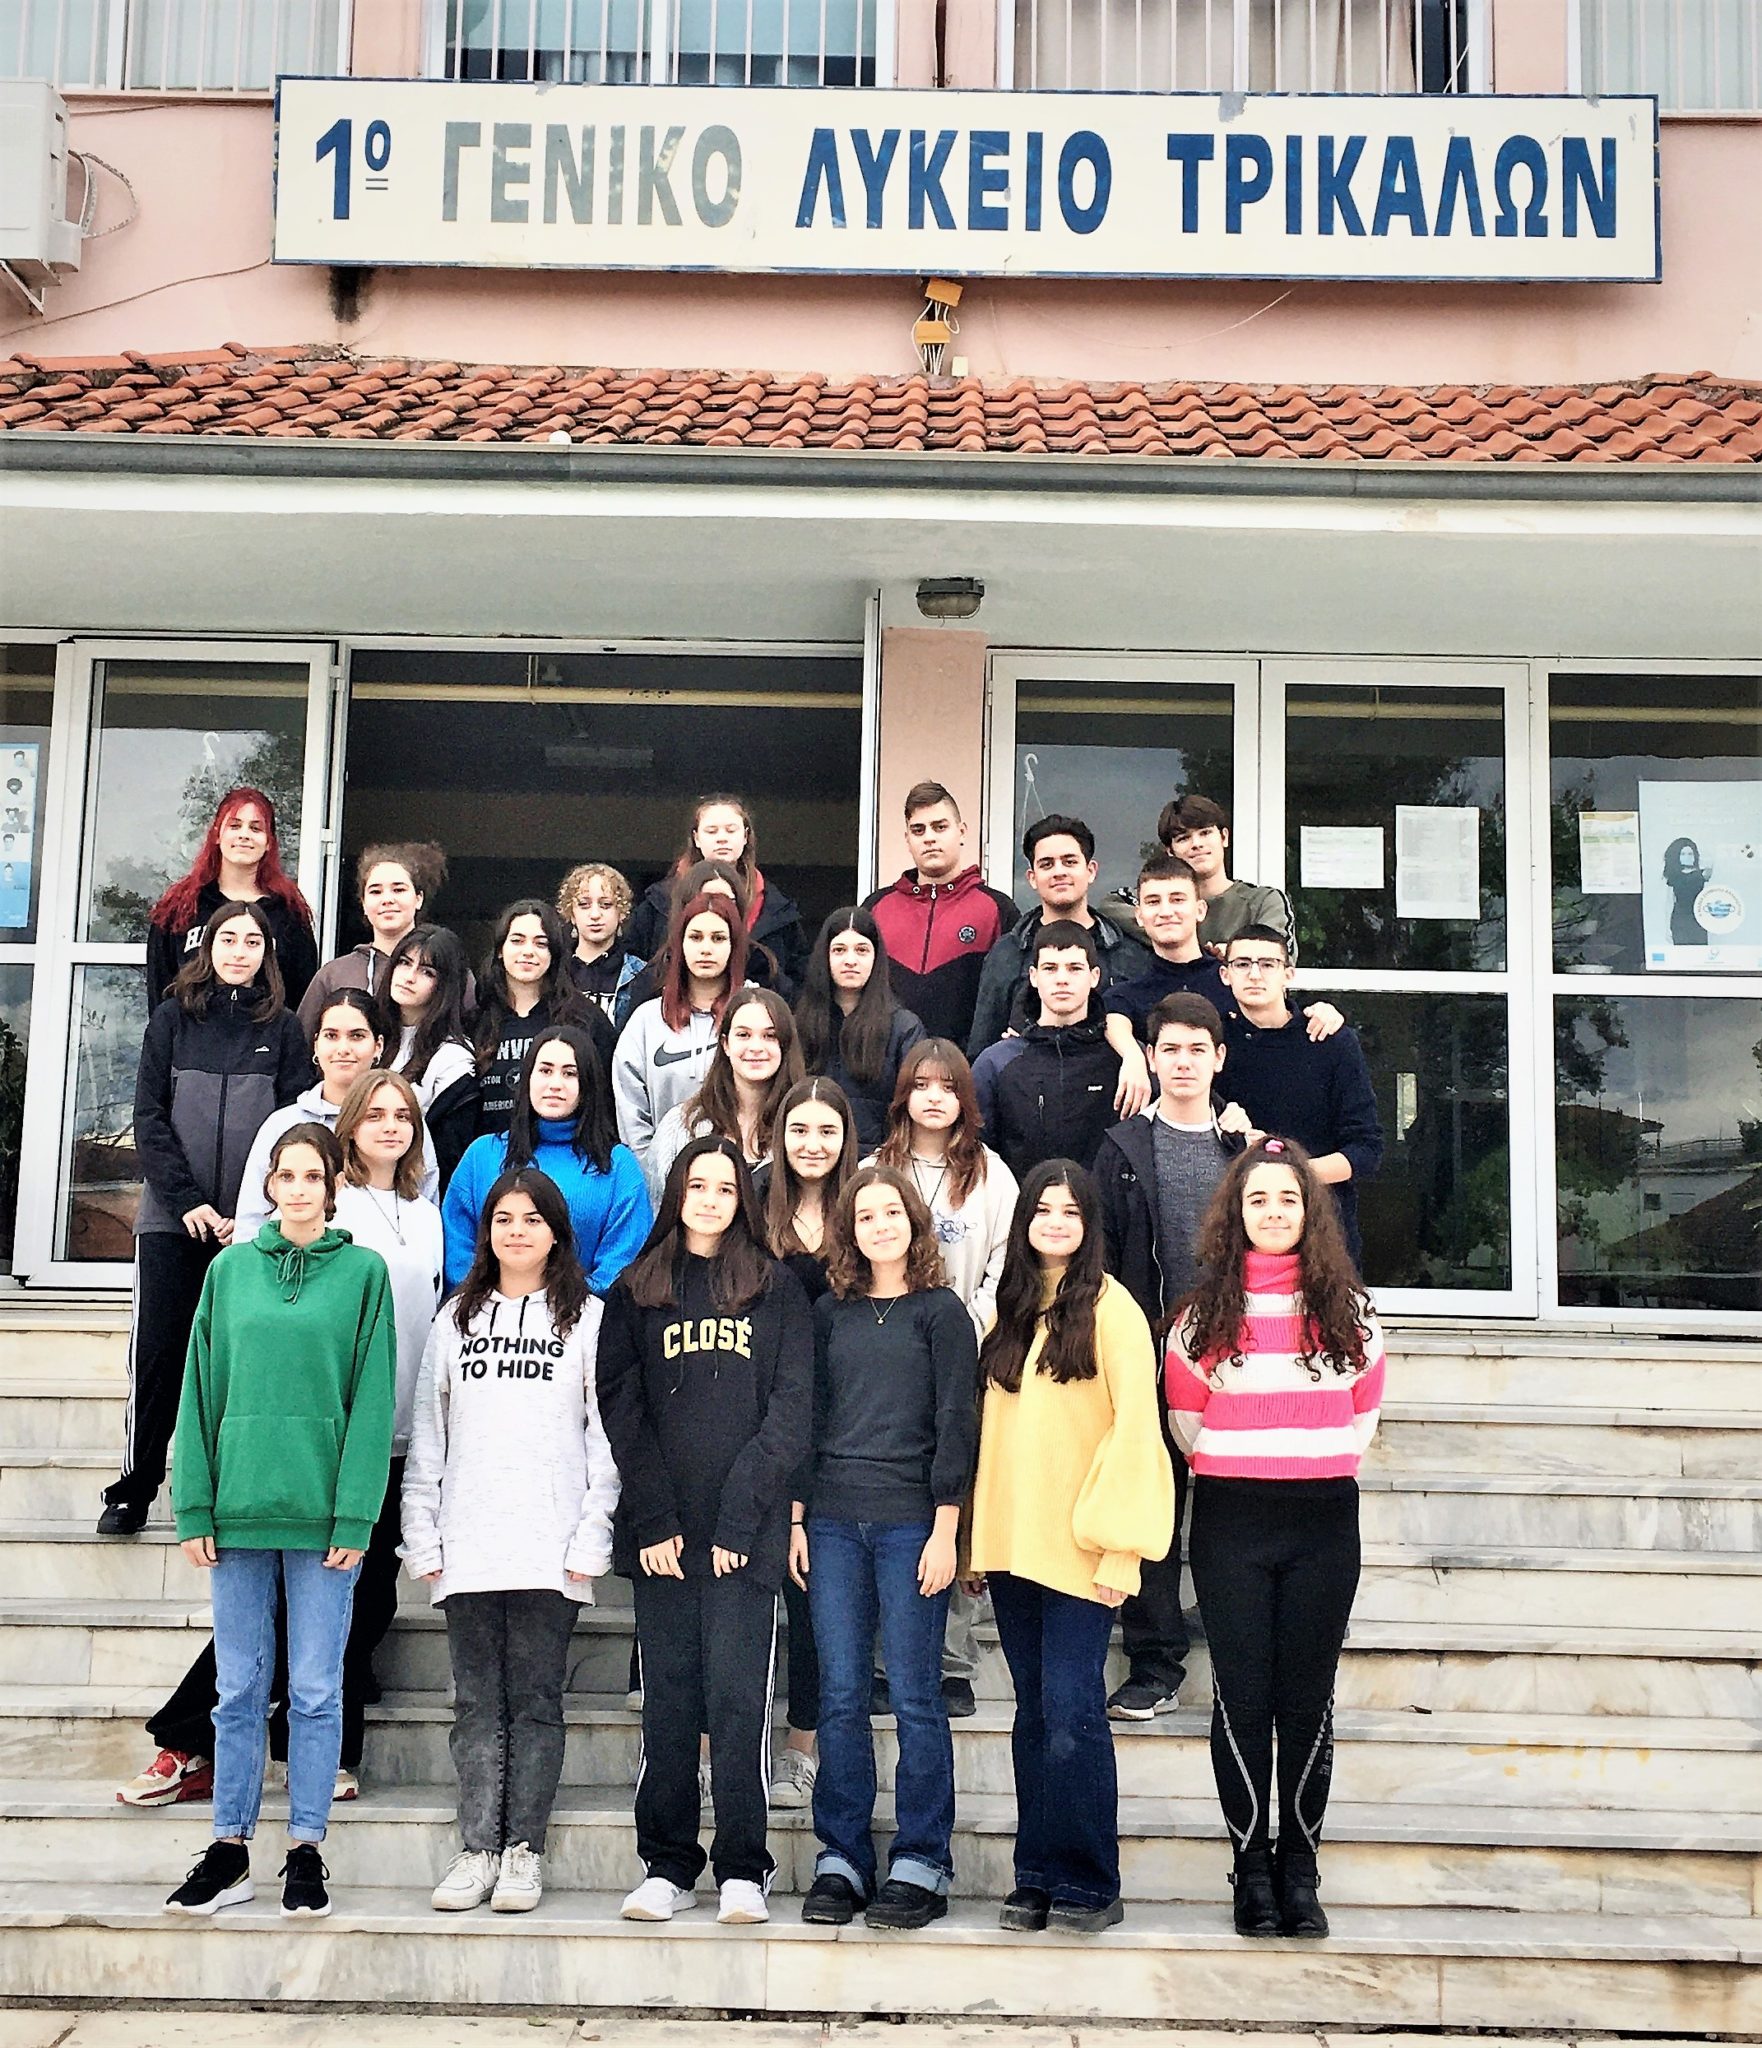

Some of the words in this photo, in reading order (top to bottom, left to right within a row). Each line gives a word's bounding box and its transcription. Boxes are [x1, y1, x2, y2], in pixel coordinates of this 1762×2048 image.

[442, 121, 742, 228] ΓΕΝΙΚΟ
[794, 127, 1113, 235] ΛΥΚΕΙΟ
[1166, 133, 1617, 239] ΤΡΙΚΑΛΩΝ
[458, 1336, 564, 1360] NOTHING
[663, 1316, 753, 1360] CLOSÉ
[461, 1359, 488, 1382] TO
[497, 1359, 554, 1382] HIDE
